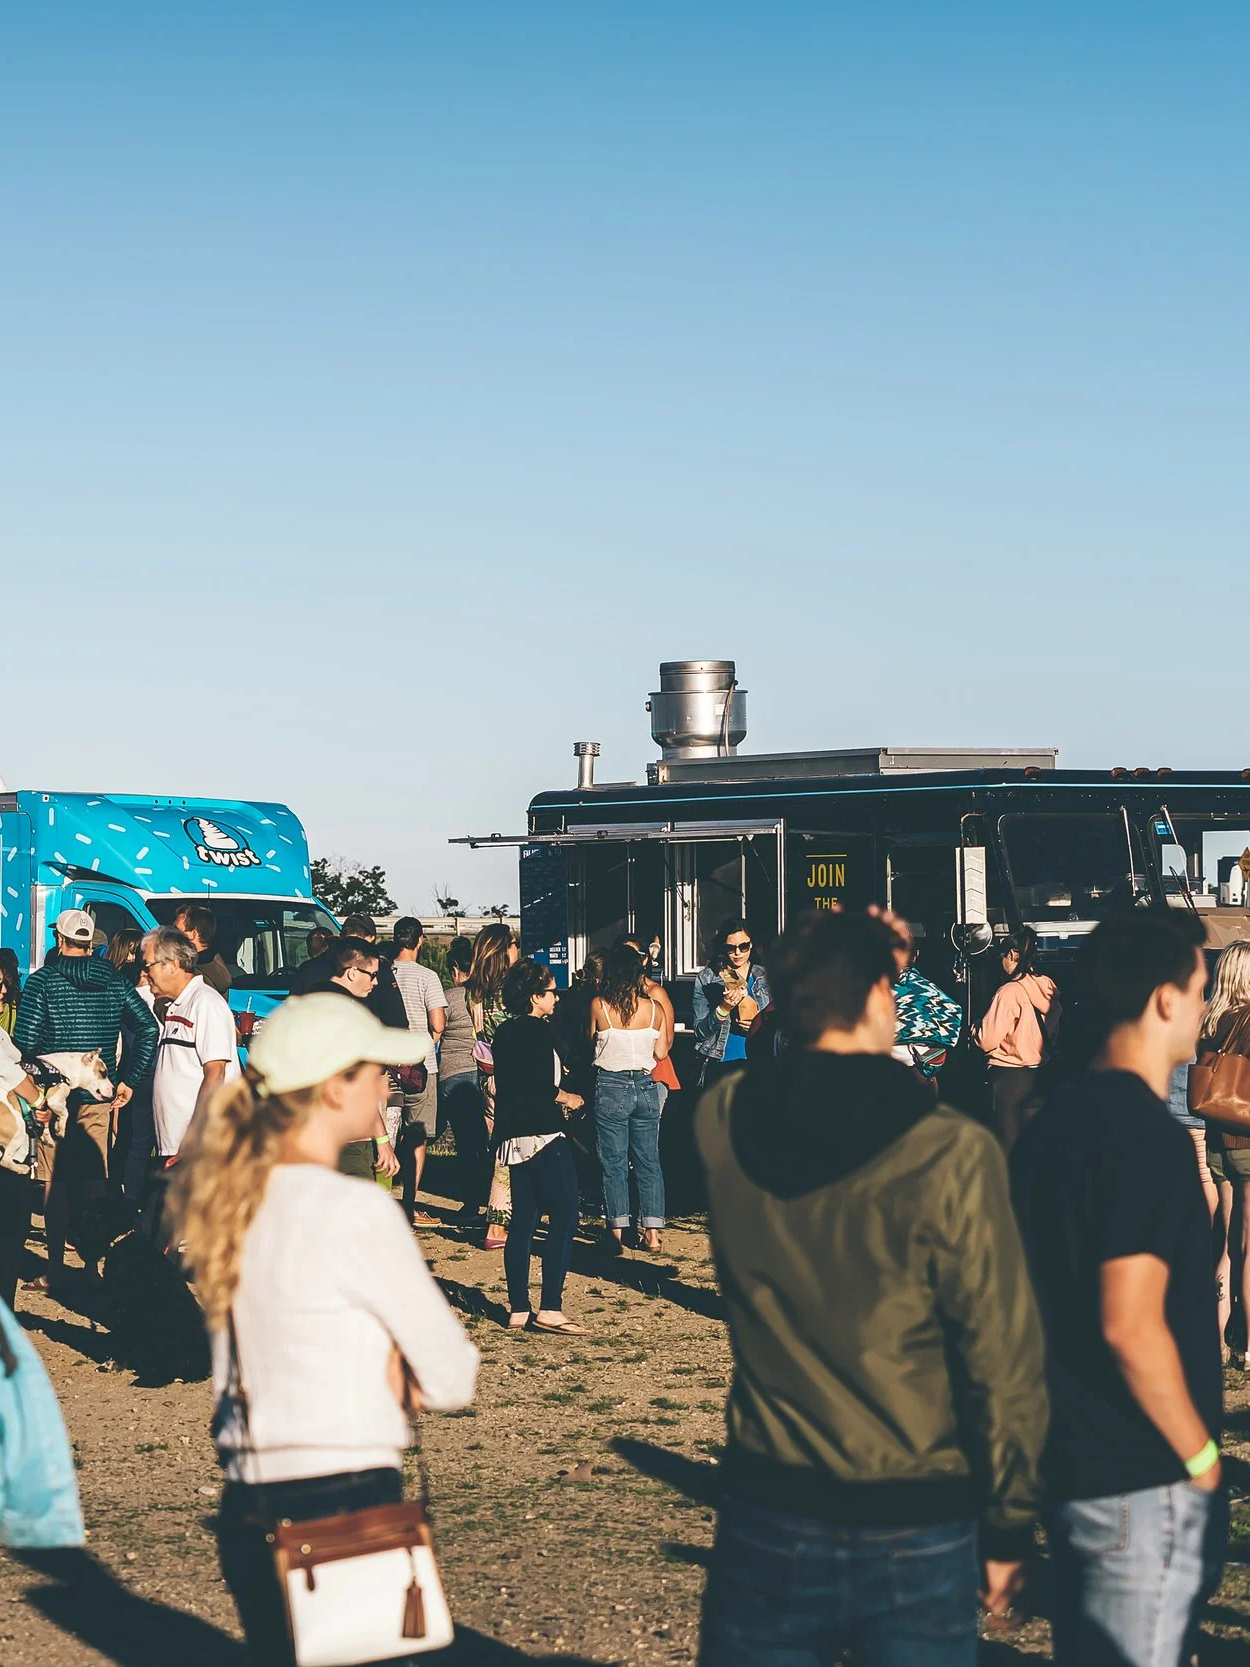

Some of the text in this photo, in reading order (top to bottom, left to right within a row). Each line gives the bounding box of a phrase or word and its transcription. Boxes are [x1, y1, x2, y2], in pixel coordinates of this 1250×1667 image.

[196, 845, 261, 866] twist
[807, 863, 845, 888] JOIN
[814, 897, 838, 910] THE
